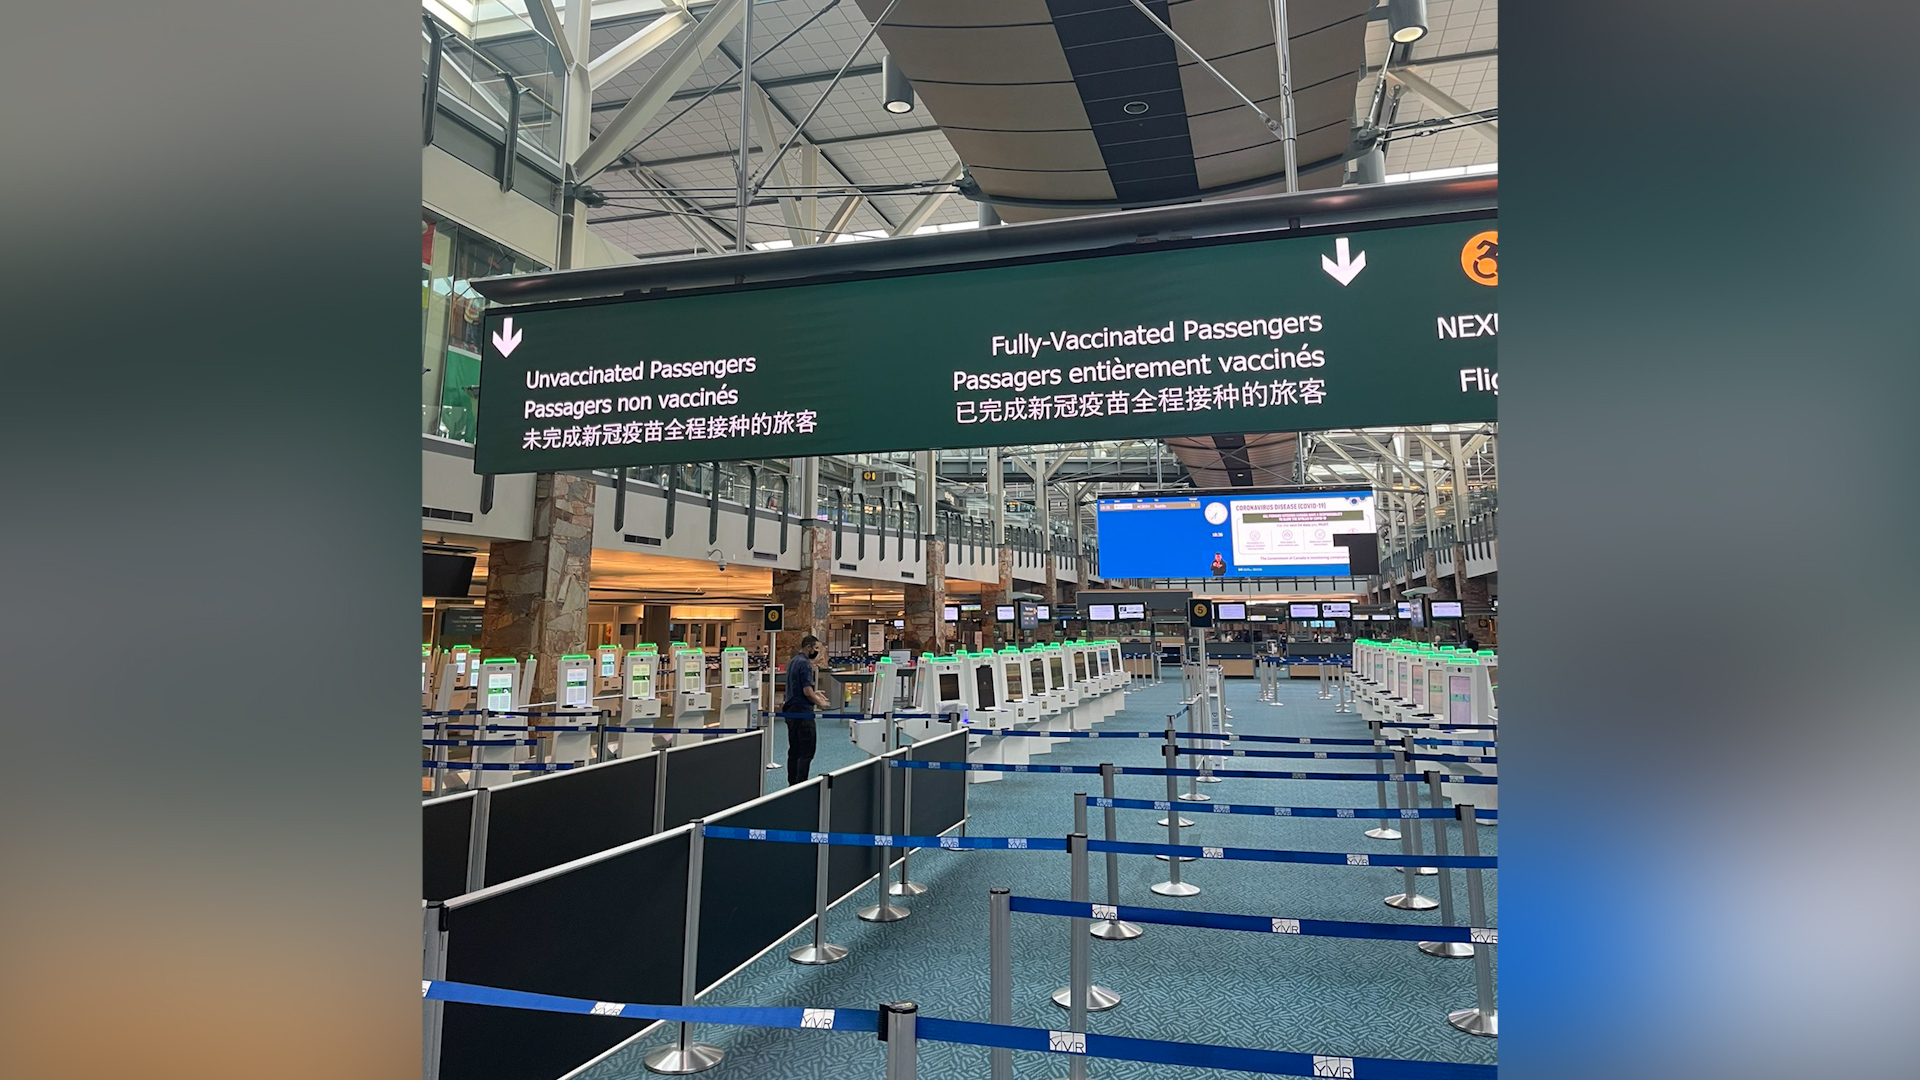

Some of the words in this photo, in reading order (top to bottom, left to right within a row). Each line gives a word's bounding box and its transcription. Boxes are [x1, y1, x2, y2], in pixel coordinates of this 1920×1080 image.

[1437, 313, 1498, 339] NEX
[991, 321, 1175, 358] Fully-Vaccinated
[1183, 313, 1323, 343] Passengers
[525, 360, 645, 389] Unvaccinated
[649, 355, 757, 380] Passengers
[953, 367, 1062, 392] Passagers
[1068, 353, 1212, 383] entièrement
[1217, 342, 1326, 373] vaccinés
[524, 398, 612, 420] Passagers
[617, 394, 651, 412] non
[658, 383, 739, 409] vaccinés
[956, 377, 1327, 425] 已完成新冠疫苗全程接种的旅客
[522, 409, 818, 451] 未完成新冠疫苗全程接种的旅客
[1236, 504, 1273, 512] CORONAVIRUS
[1274, 503, 1297, 511] DISEASE
[1298, 502, 1326, 510] (COVID-19)
[1197, 606, 1204, 614] 5
[1092, 909, 1117, 920] YVR
[1272, 923, 1299, 934] YVR
[592, 1004, 621, 1016] YVR
[801, 1015, 832, 1030] YVR
[1050, 1038, 1085, 1053] YVR
[1313, 1062, 1353, 1079] YVR
